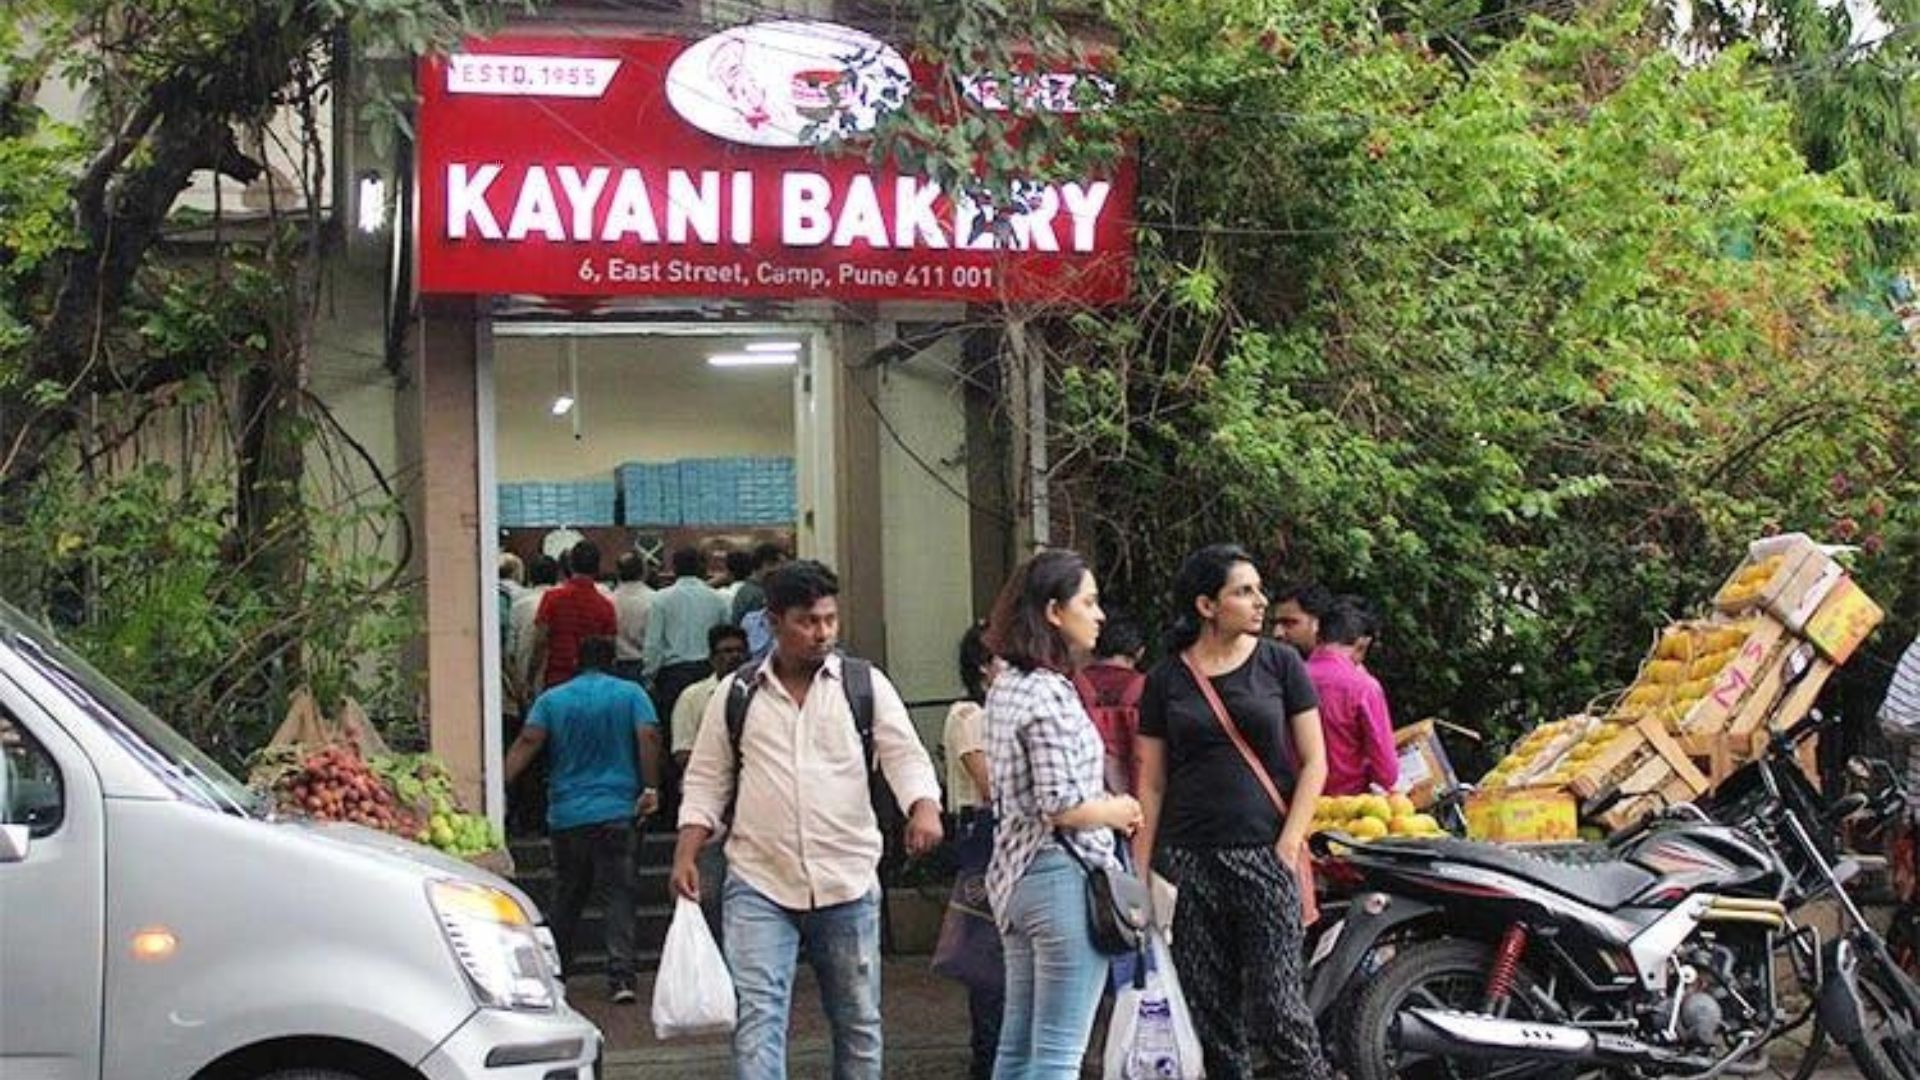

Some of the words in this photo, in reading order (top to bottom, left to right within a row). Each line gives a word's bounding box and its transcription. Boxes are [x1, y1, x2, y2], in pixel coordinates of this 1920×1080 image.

[448, 162, 754, 244] KAYANI
[578, 258, 602, 283] 6,
[608, 258, 661, 282] East
[668, 260, 749, 286] Street,
[757, 262, 832, 289] Camp,
[838, 263, 898, 286] Pune
[903, 265, 944, 286] 411
[952, 265, 993, 288] 001
